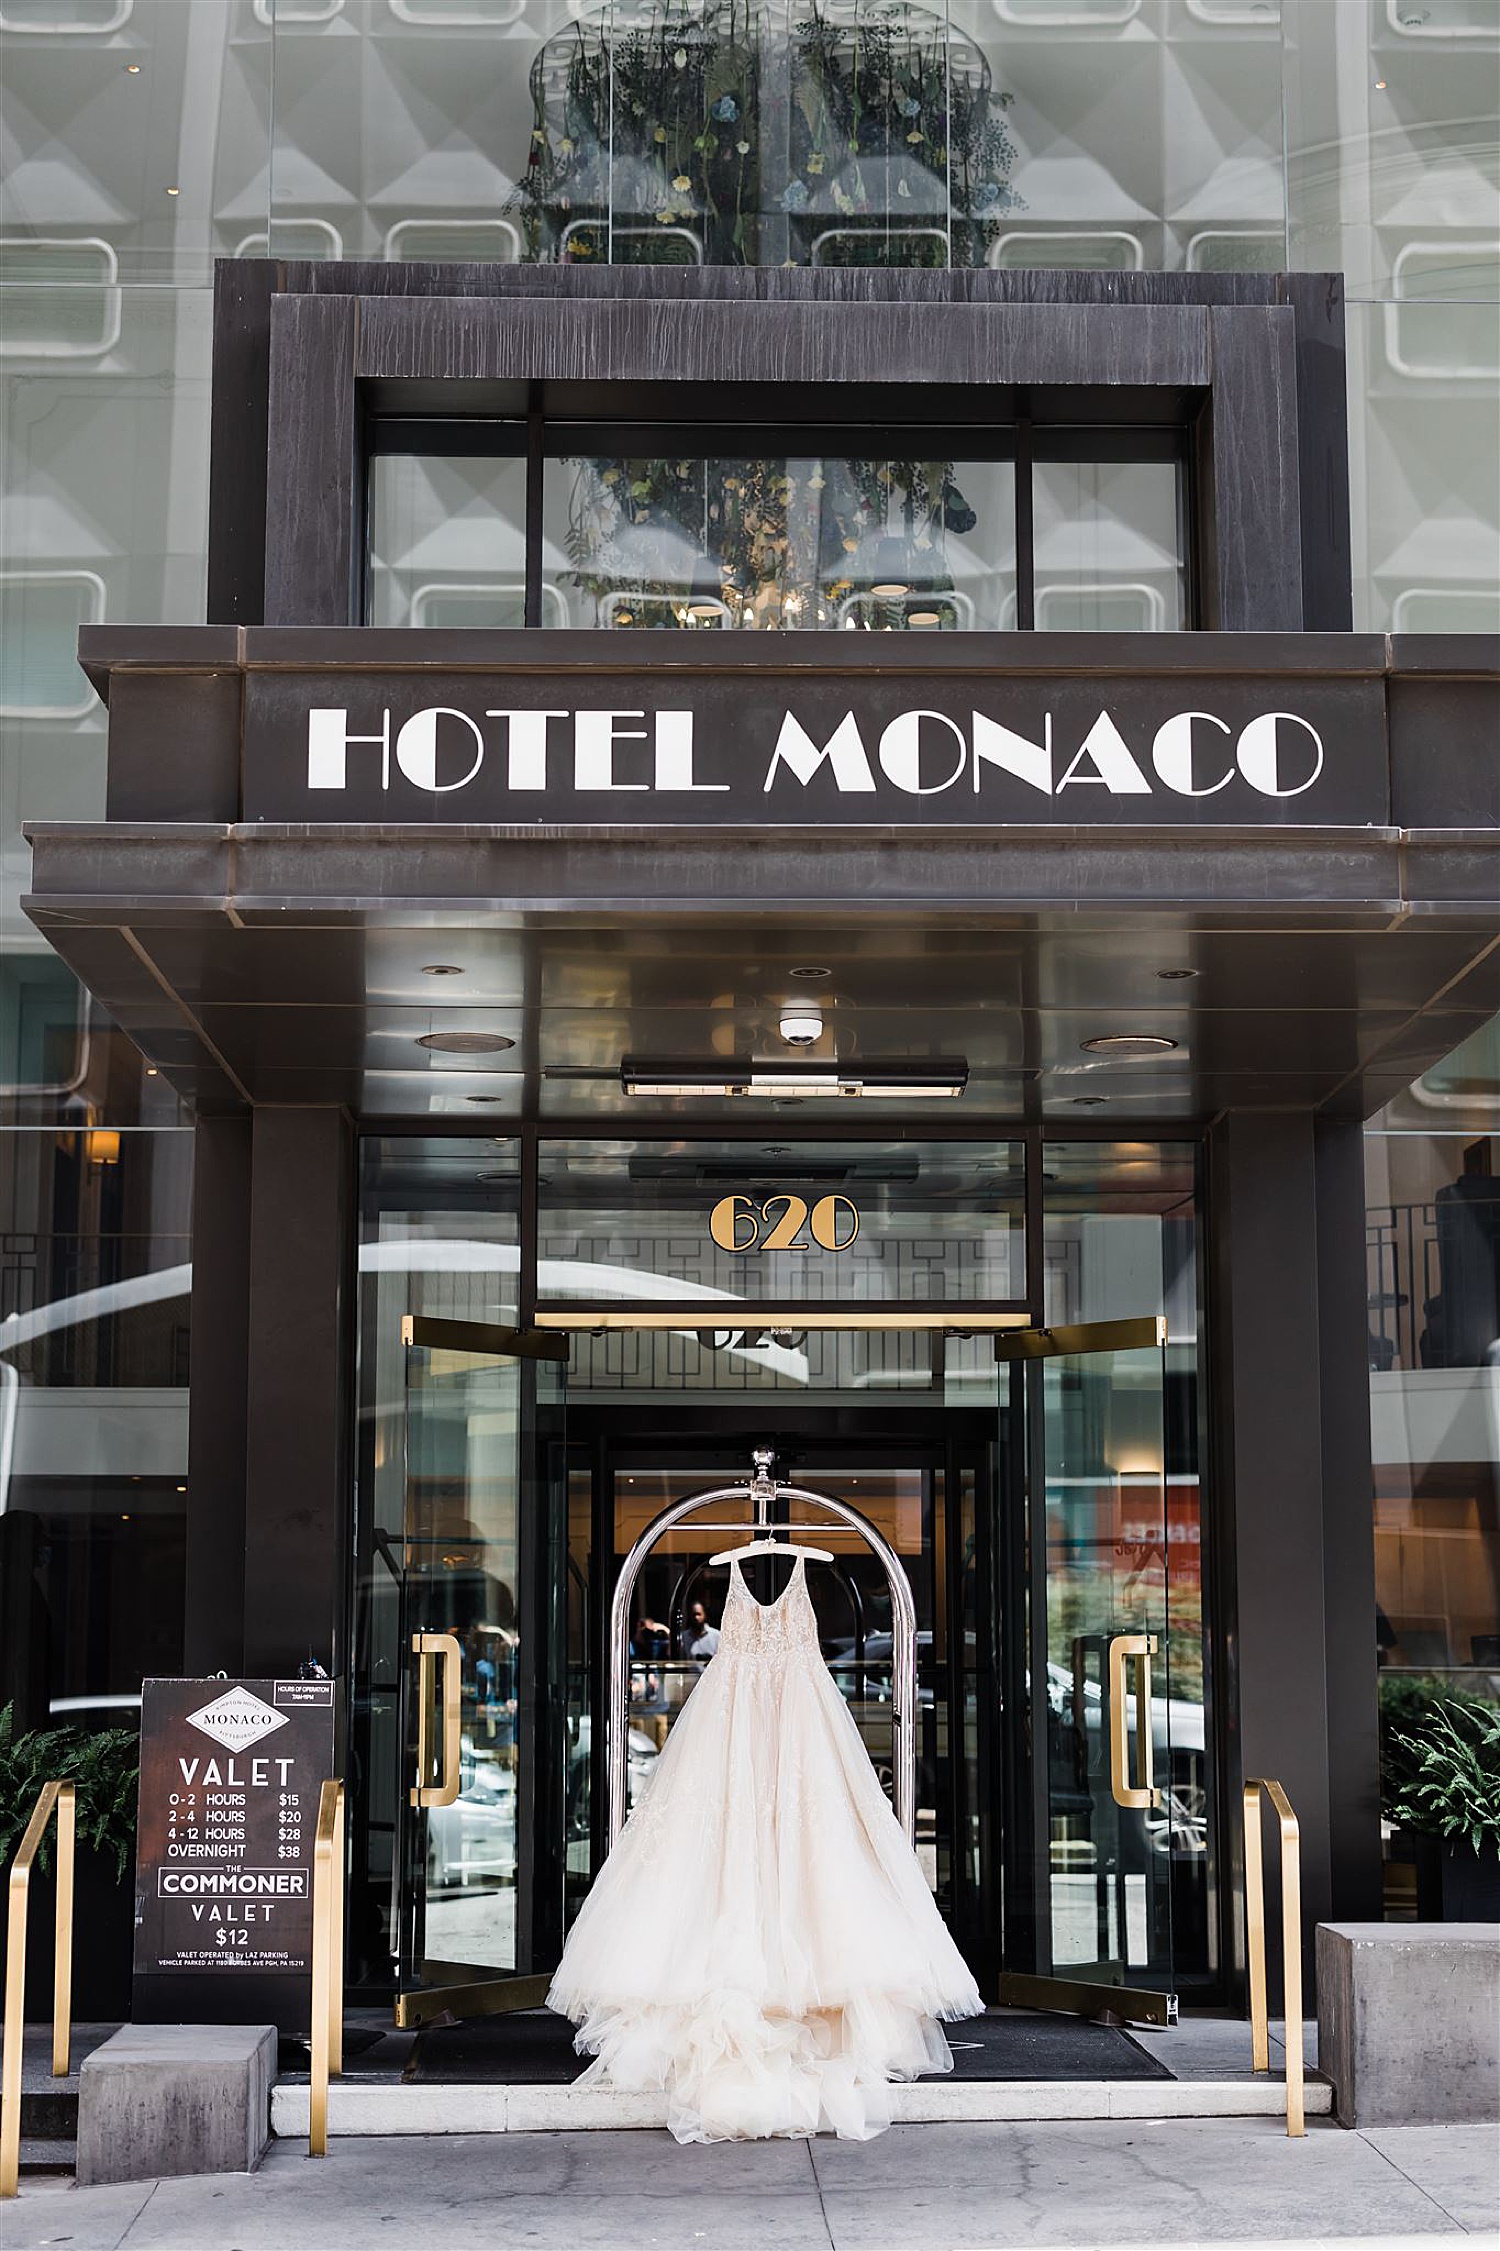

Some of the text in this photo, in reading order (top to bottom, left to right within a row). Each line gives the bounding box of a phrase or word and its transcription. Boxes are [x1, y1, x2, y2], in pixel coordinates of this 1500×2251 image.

[307, 707, 1324, 797] HOTEL MONACO
[709, 1194, 860, 1252] 620
[203, 1714, 272, 1725] MONACO
[178, 1757, 295, 1787] VALET
[206, 1793, 246, 1806] HOURS
[279, 1793, 300, 1807] $15
[206, 1810, 246, 1822] HOURS
[278, 1809, 301, 1824] $20
[205, 1827, 246, 1840] HOURS
[278, 1826, 301, 1841] $28
[167, 1844, 301, 1859] OVERNIGHT $38
[226, 1864, 242, 1873] THE
[163, 1874, 304, 1893] COMMONER
[191, 1904, 275, 1922] VALET
[215, 1927, 249, 1946] $12
[176, 1951, 198, 1959] VALET
[199, 1951, 235, 1959] OPERATED
[245, 1951, 258, 1959] LAZ
[259, 1951, 289, 1959] PARKING
